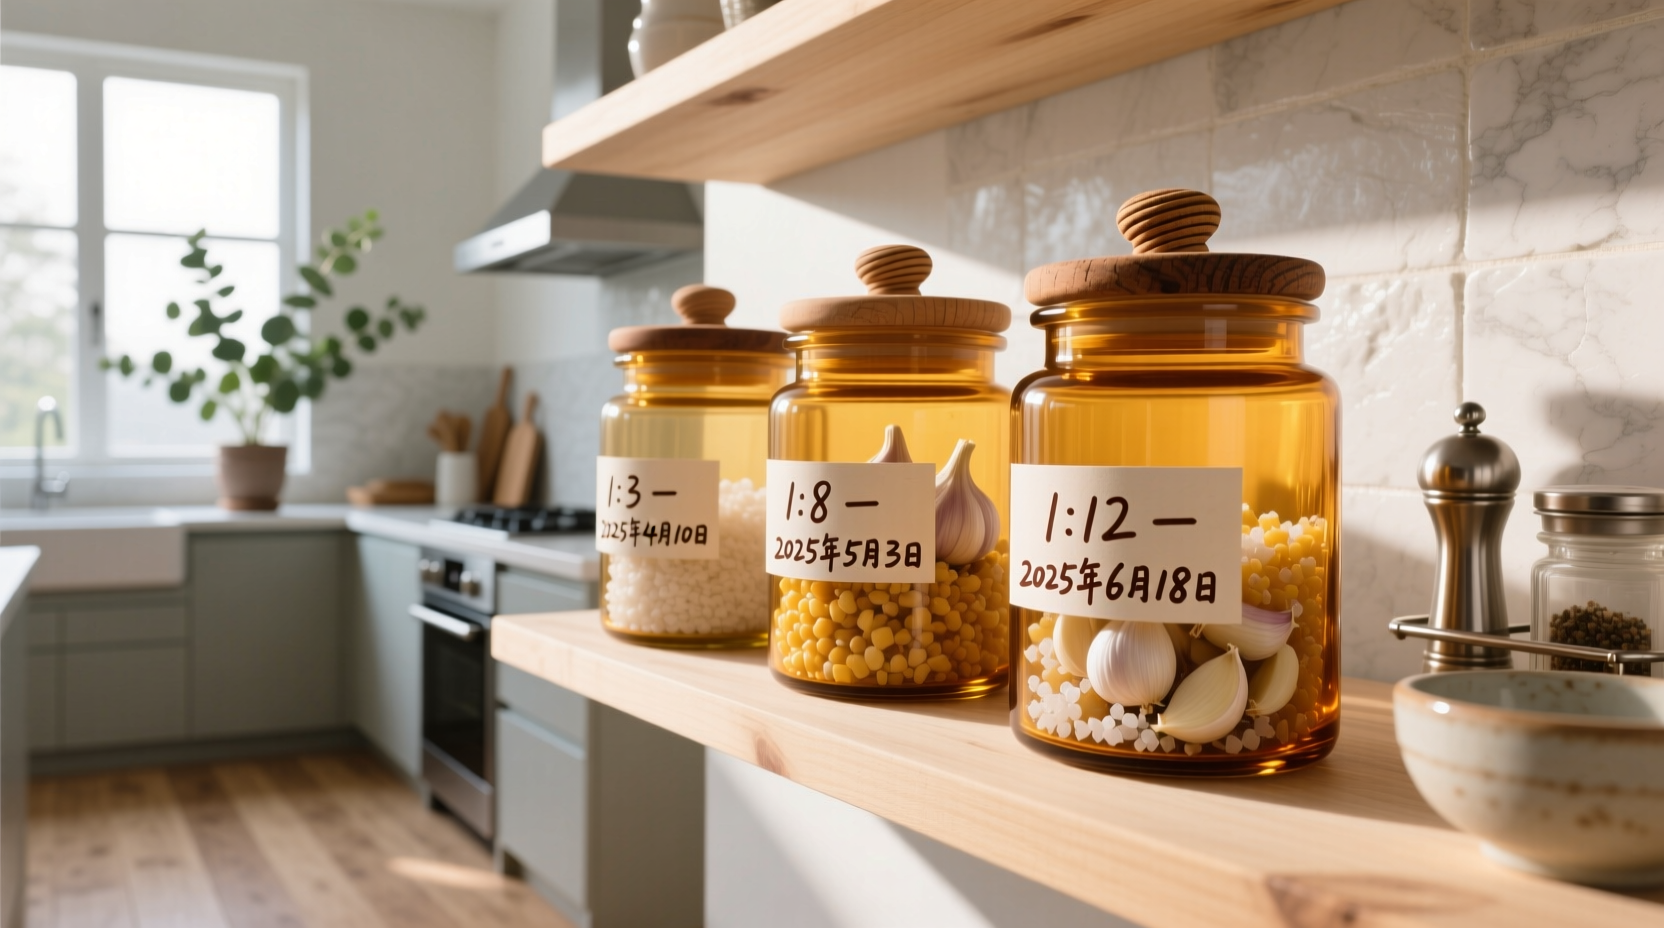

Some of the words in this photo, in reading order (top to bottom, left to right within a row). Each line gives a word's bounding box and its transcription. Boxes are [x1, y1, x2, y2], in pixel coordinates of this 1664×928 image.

[608, 475, 641, 509] 1:3
[786, 480, 832, 523] 1:8
[1045, 491, 1137, 544] 1:12
[774, 533, 922, 573] 2025年5月3日
[1019, 557, 1217, 606] 2025年6月18日
